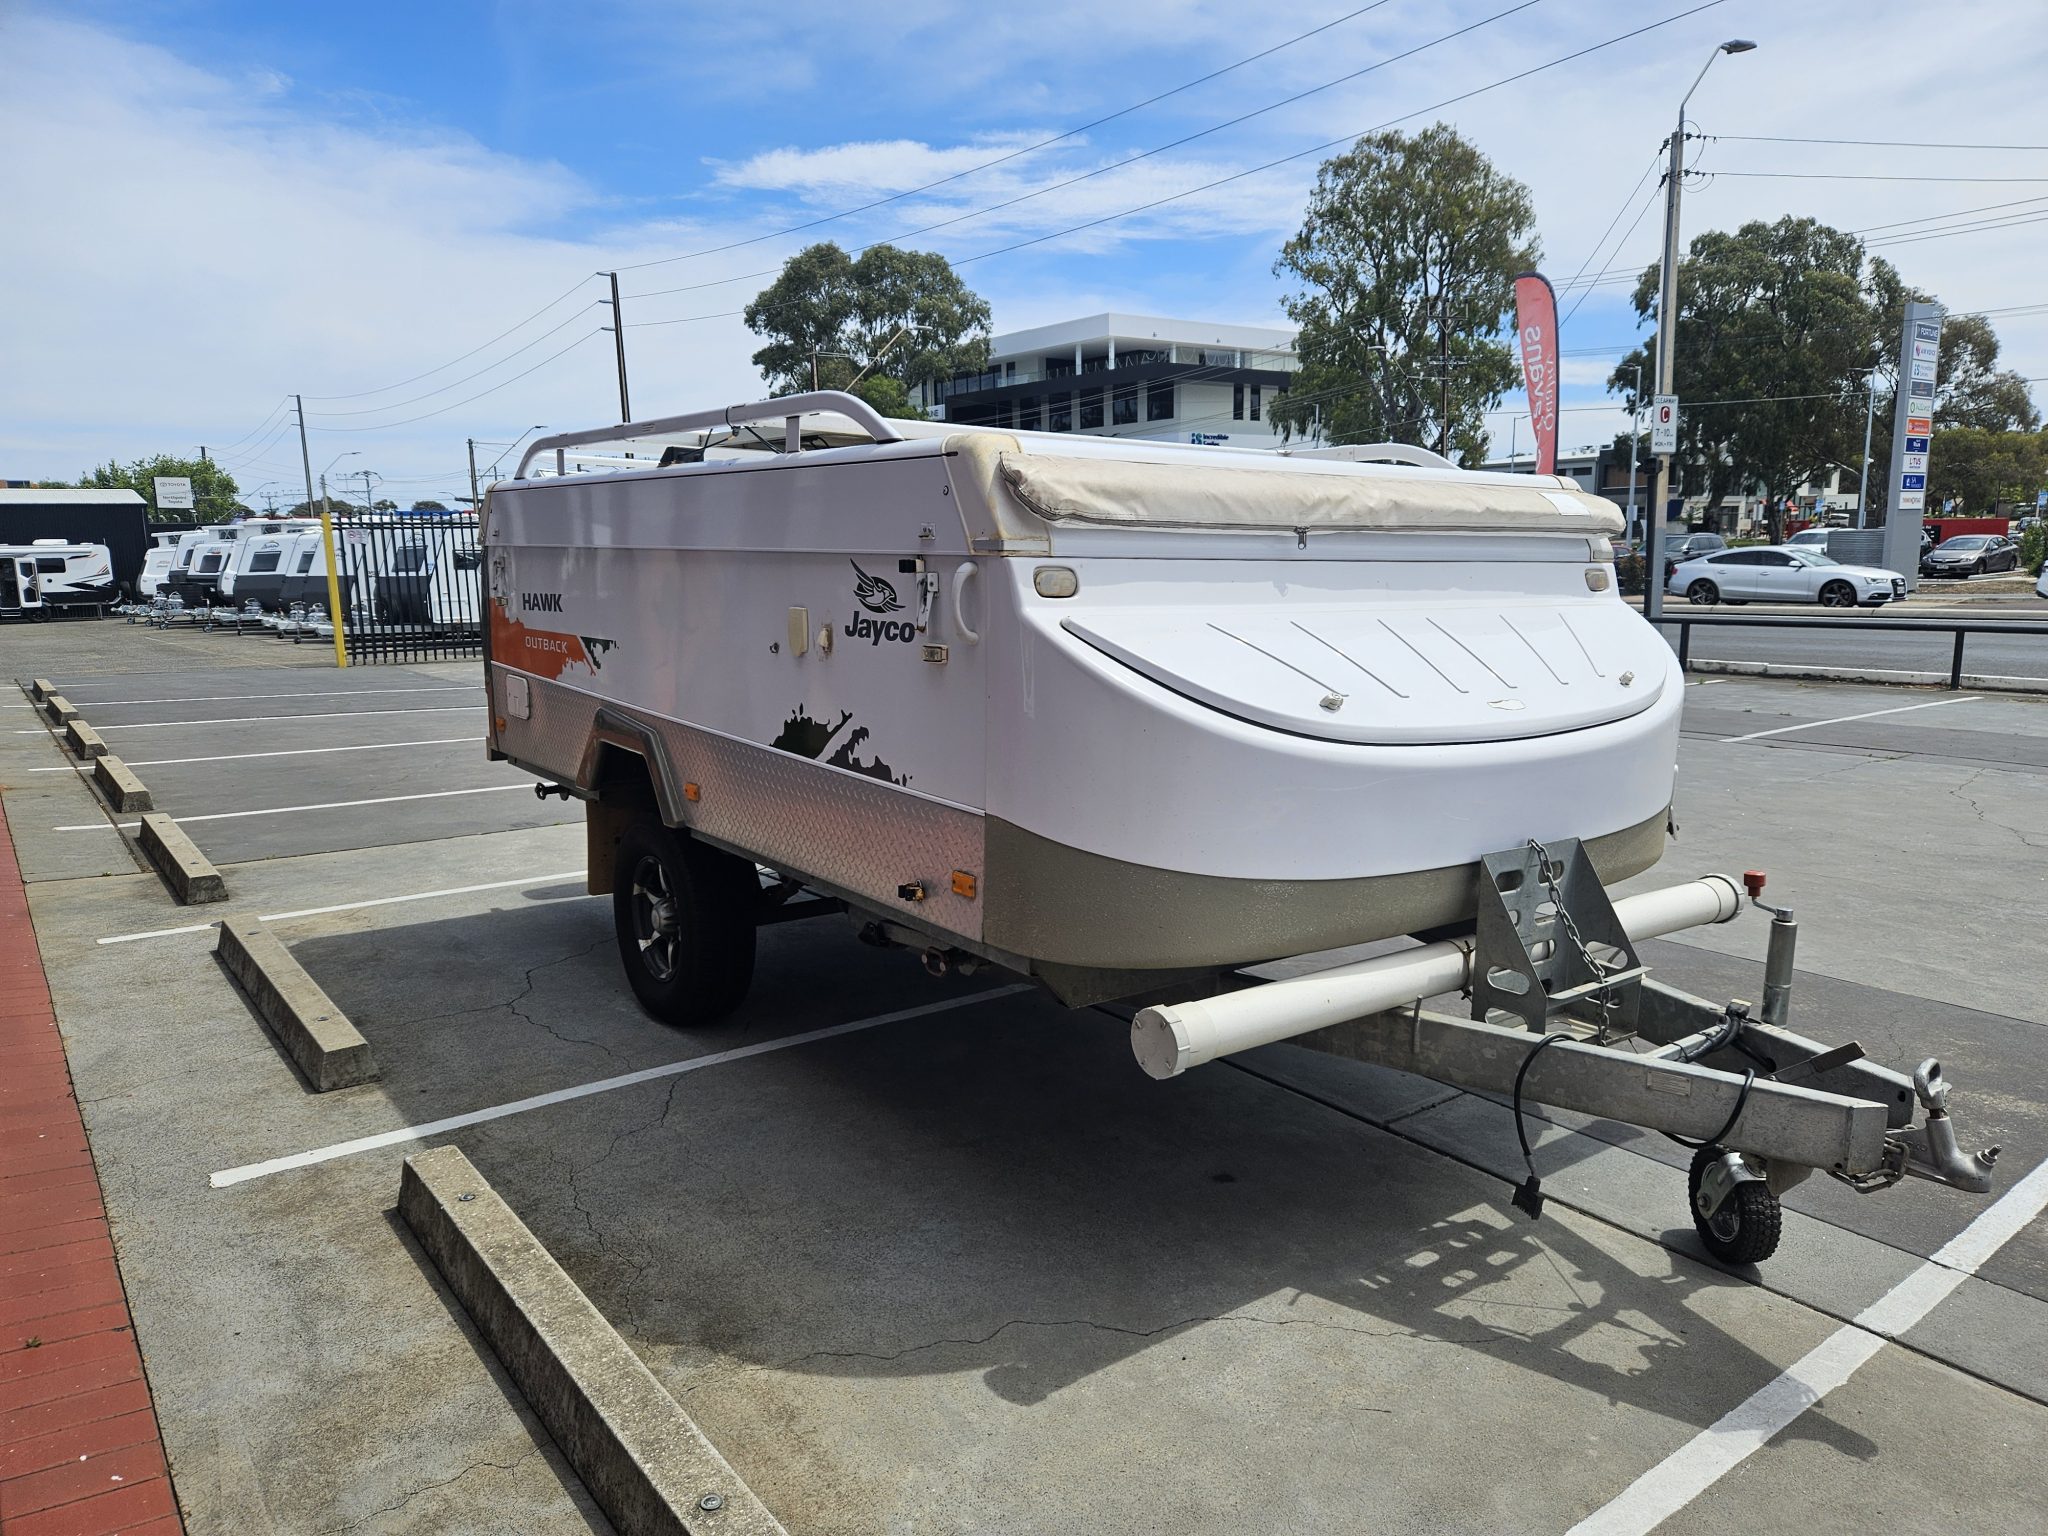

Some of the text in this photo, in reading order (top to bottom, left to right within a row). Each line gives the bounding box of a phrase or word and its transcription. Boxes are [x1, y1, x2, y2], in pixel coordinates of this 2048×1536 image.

[522, 592, 564, 612] HAWK
[844, 610, 916, 646] Jayco
[525, 636, 568, 654] OUTBACK
